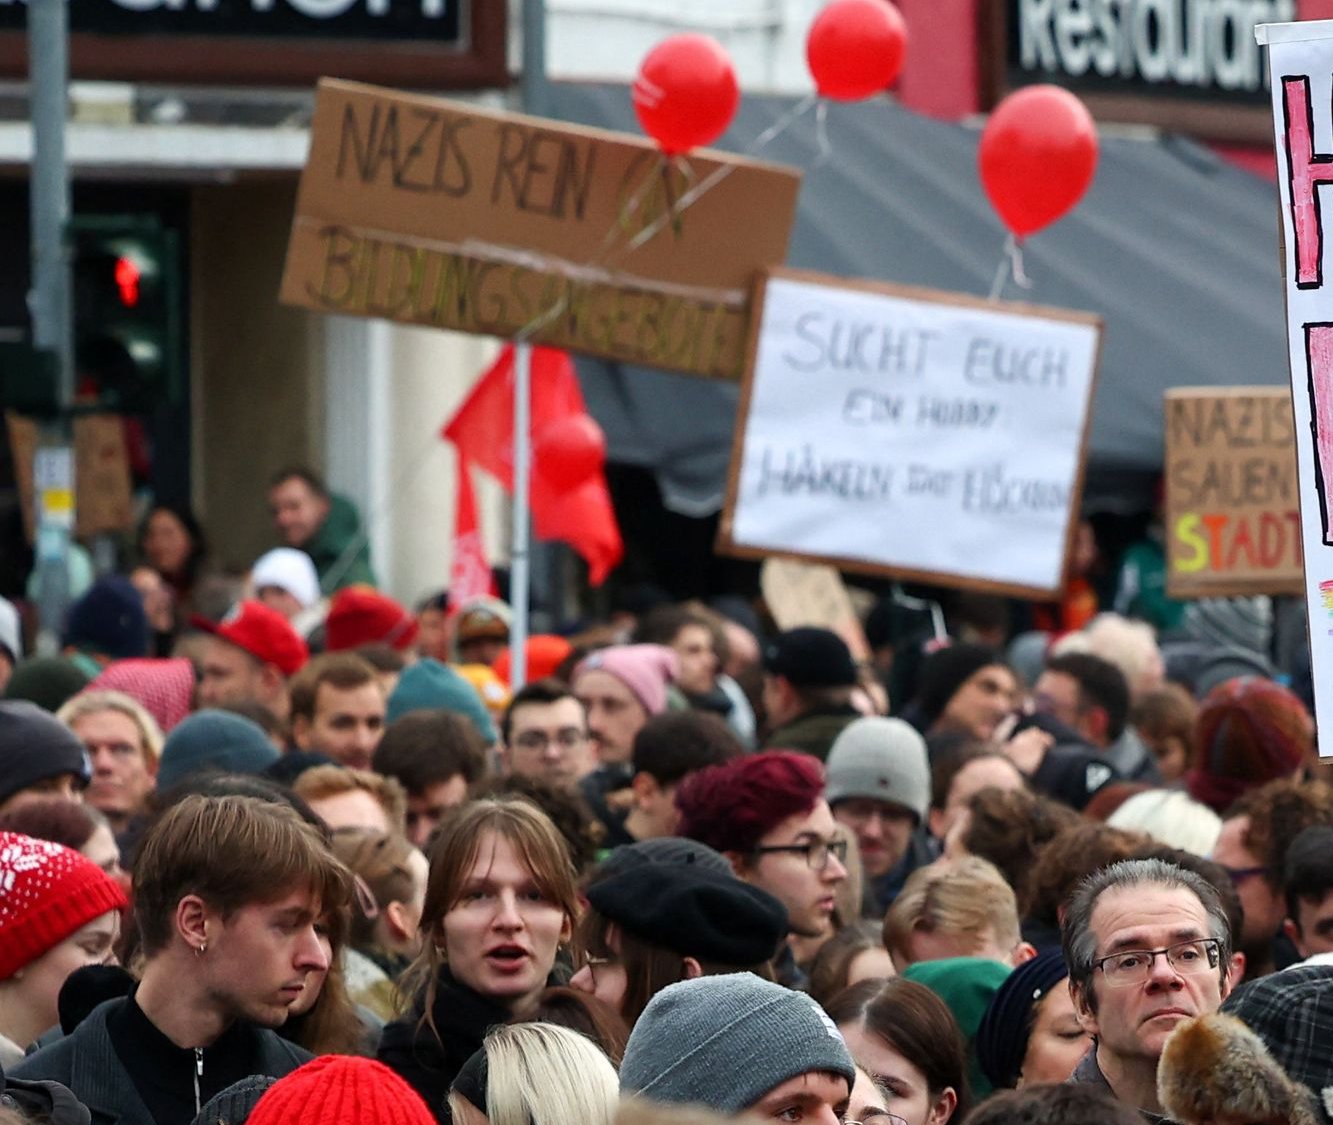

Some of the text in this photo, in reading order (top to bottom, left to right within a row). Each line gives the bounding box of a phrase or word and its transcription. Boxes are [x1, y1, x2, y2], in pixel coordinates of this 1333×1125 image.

[336, 103, 473, 196] NAZIS
[491, 124, 598, 221] REIN
[781, 310, 1071, 388] SUCHT EUCH
[1171, 397, 1294, 448] NAZIS
